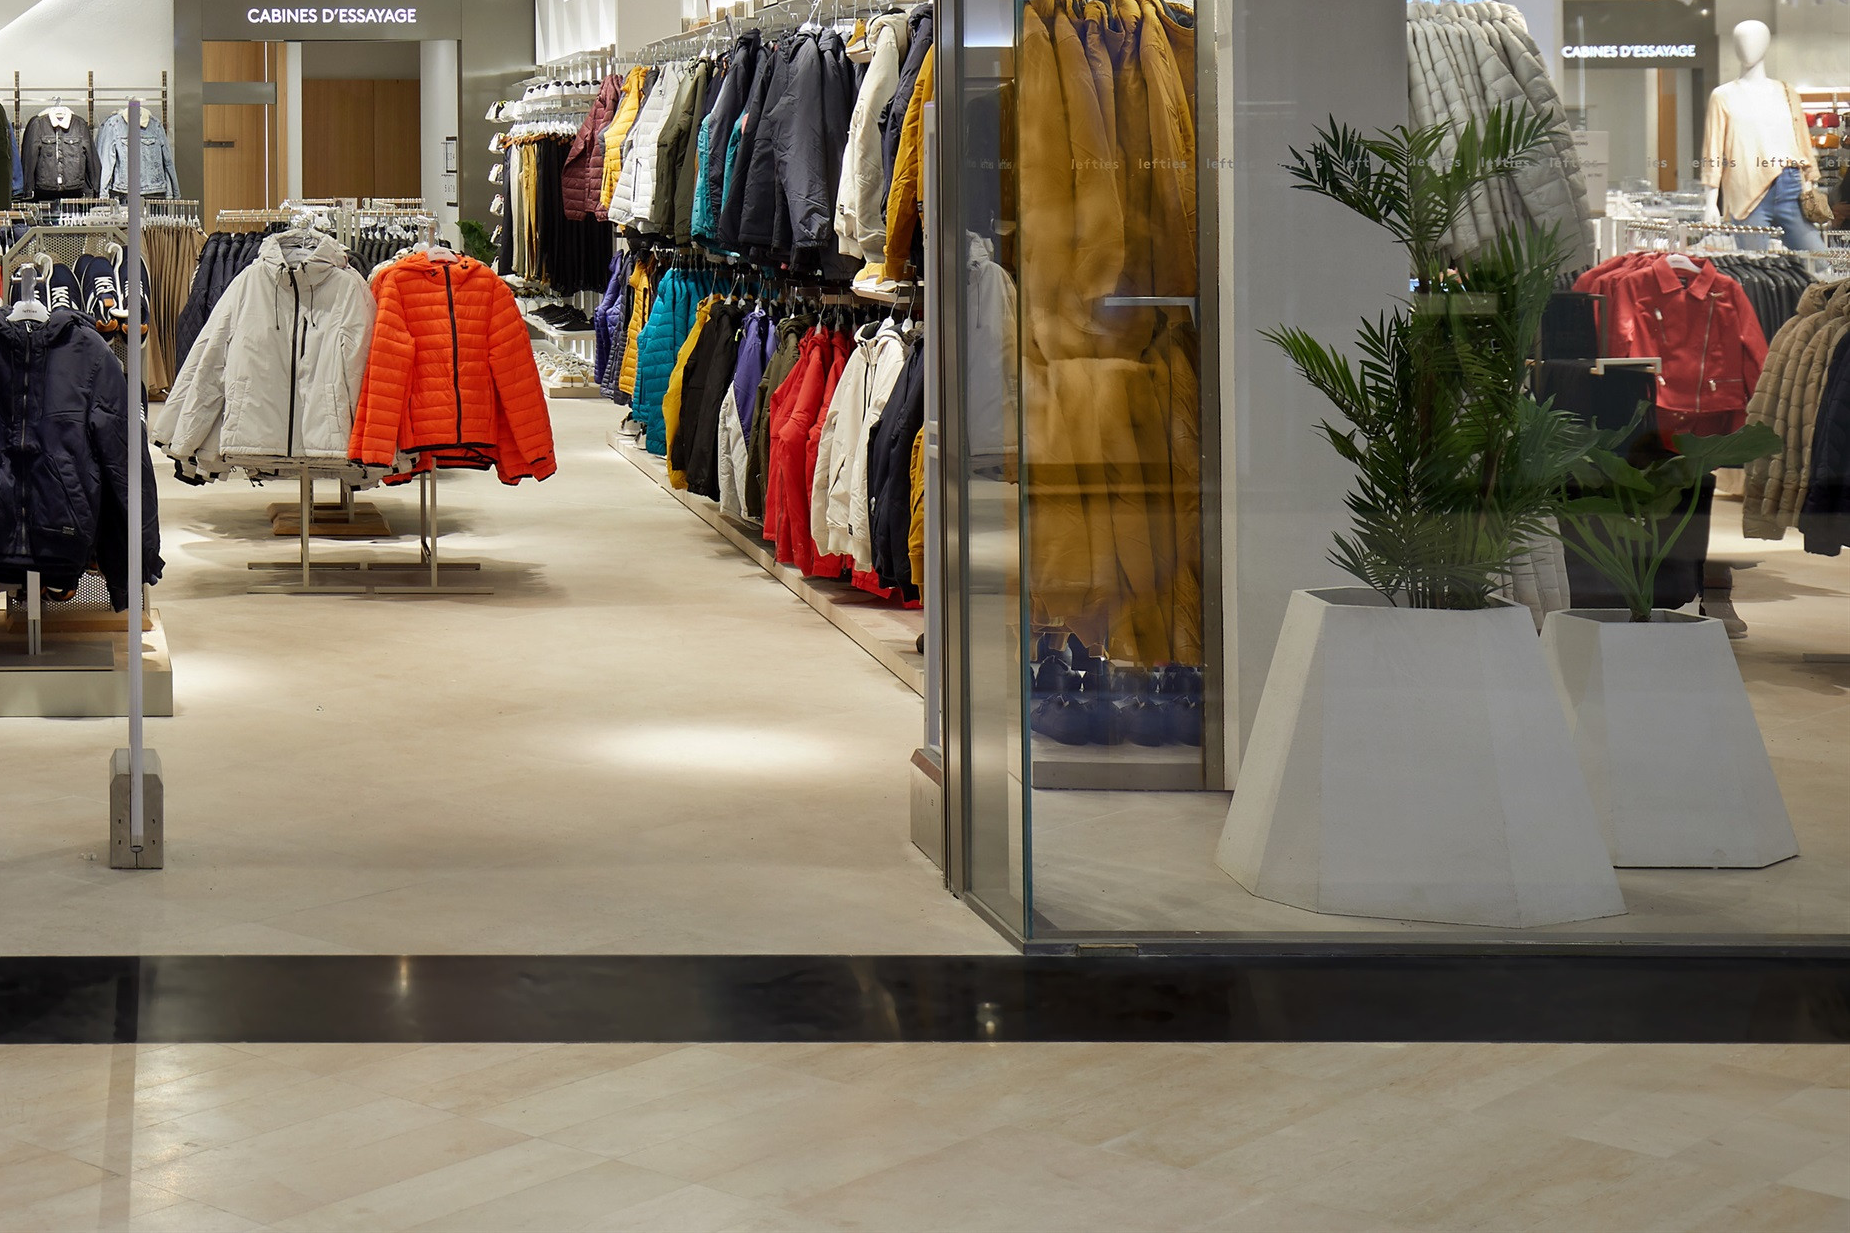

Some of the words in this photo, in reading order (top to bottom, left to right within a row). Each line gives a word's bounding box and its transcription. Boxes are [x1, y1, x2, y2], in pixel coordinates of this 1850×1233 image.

[247, 8, 318, 24] CABINES
[322, 8, 417, 24] D'ESSAYAGE
[1561, 45, 1618, 58] CABINES
[1619, 44, 1696, 57] D'ESSAYAGE
[1071, 158, 1120, 170] lefties
[1138, 158, 1187, 170] lefties
[1691, 156, 1737, 168] efties
[1756, 156, 1806, 168] lefties
[1825, 156, 1850, 168] left
